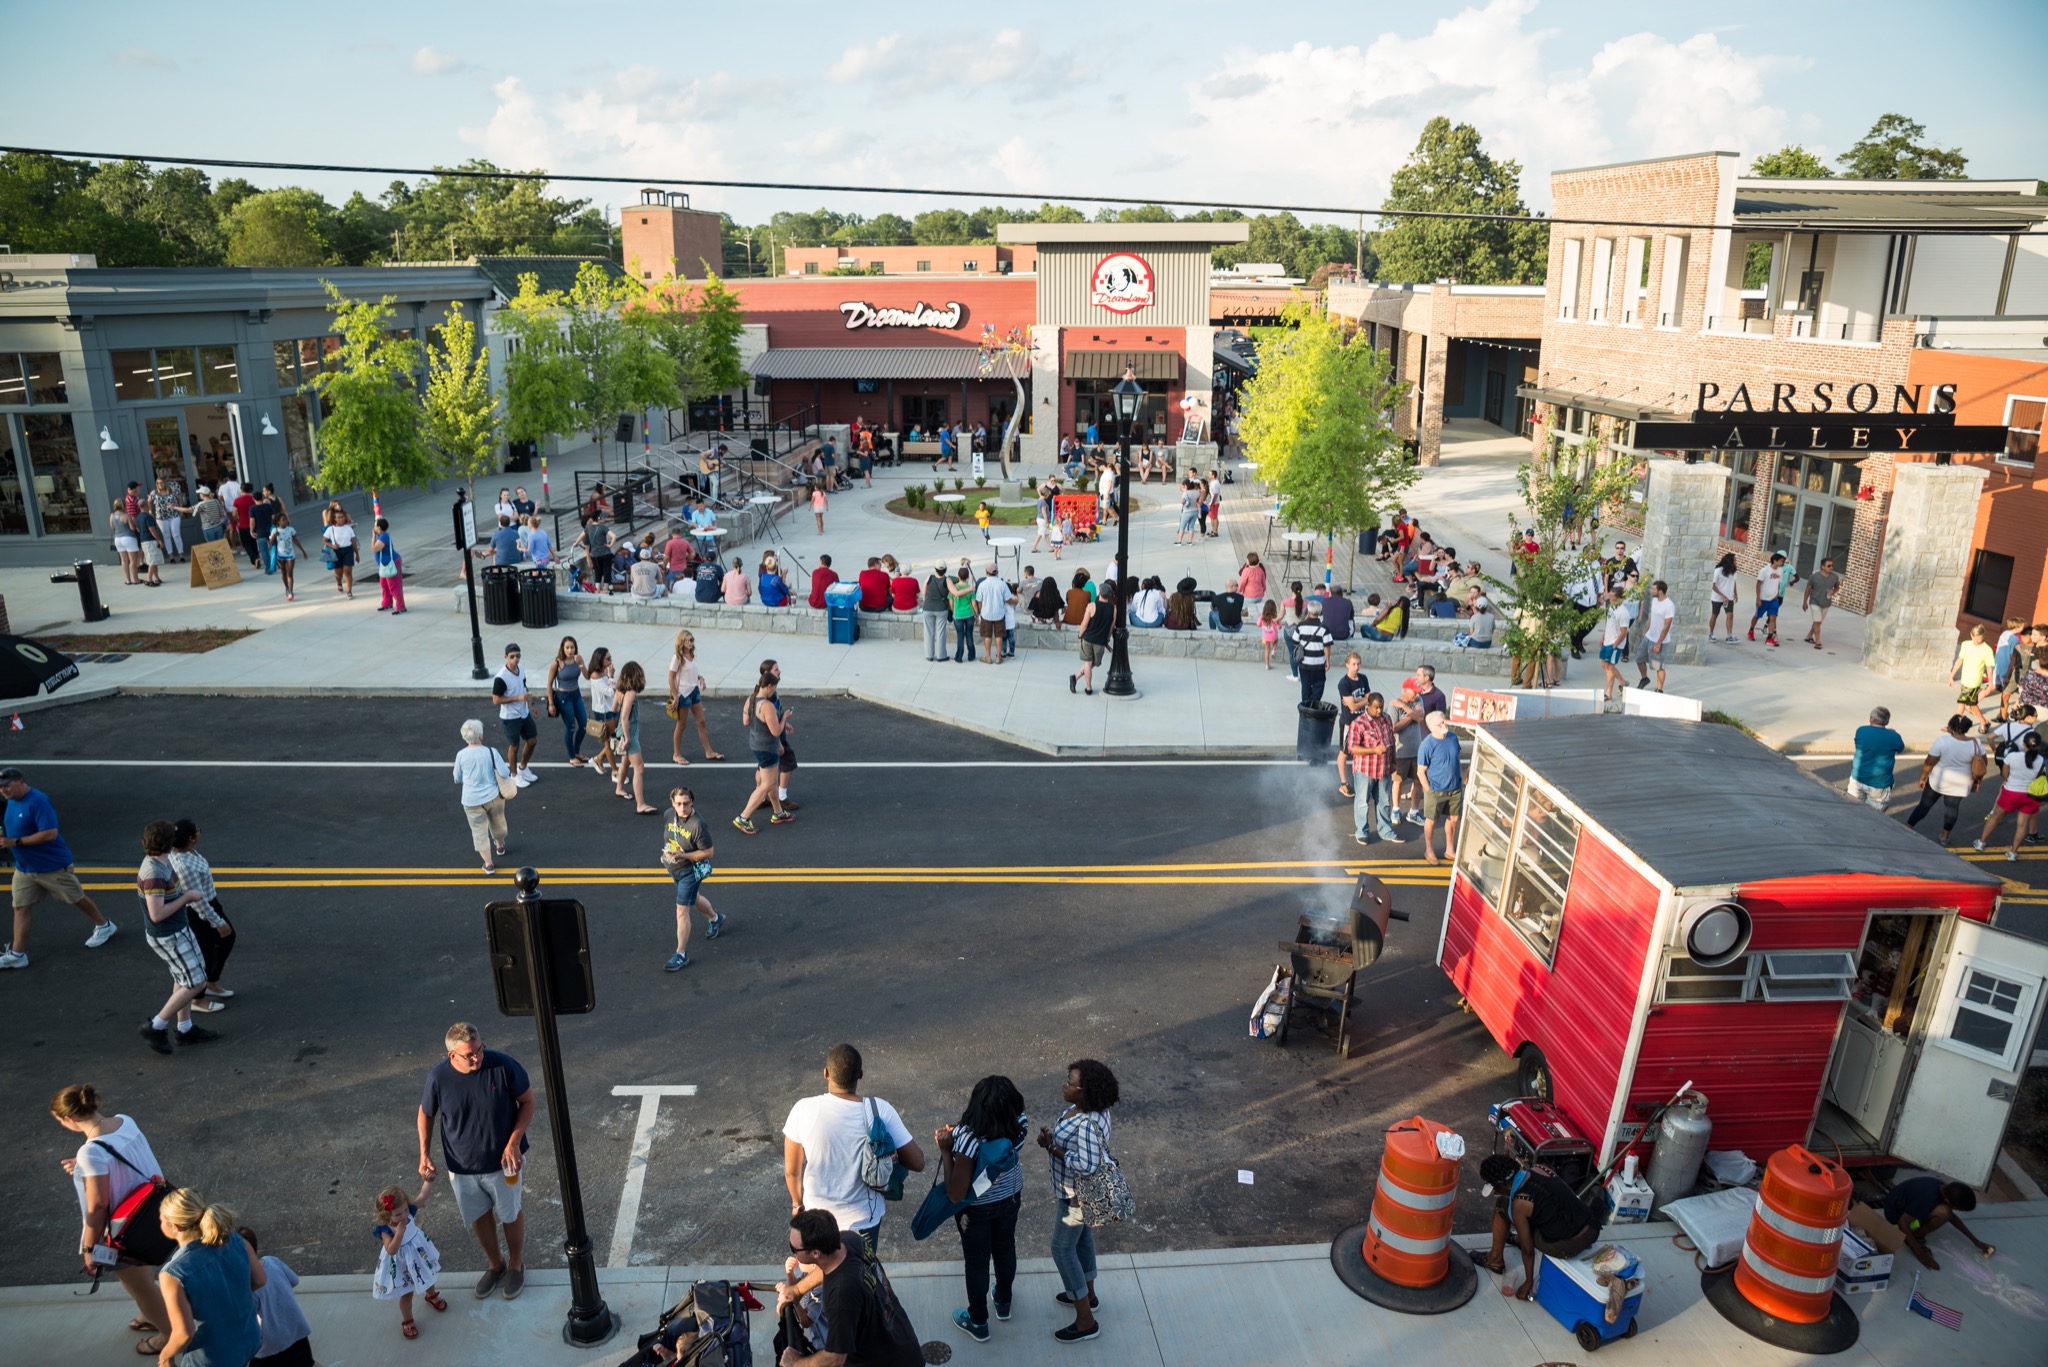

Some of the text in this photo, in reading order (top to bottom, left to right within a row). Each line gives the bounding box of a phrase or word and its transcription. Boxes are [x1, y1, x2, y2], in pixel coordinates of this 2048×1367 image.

[1096, 293, 1151, 304] Dreamland
[839, 300, 961, 329] Dreamland
[1697, 382, 1958, 414] PARSONS
[1723, 426, 1917, 449] ALLEY
